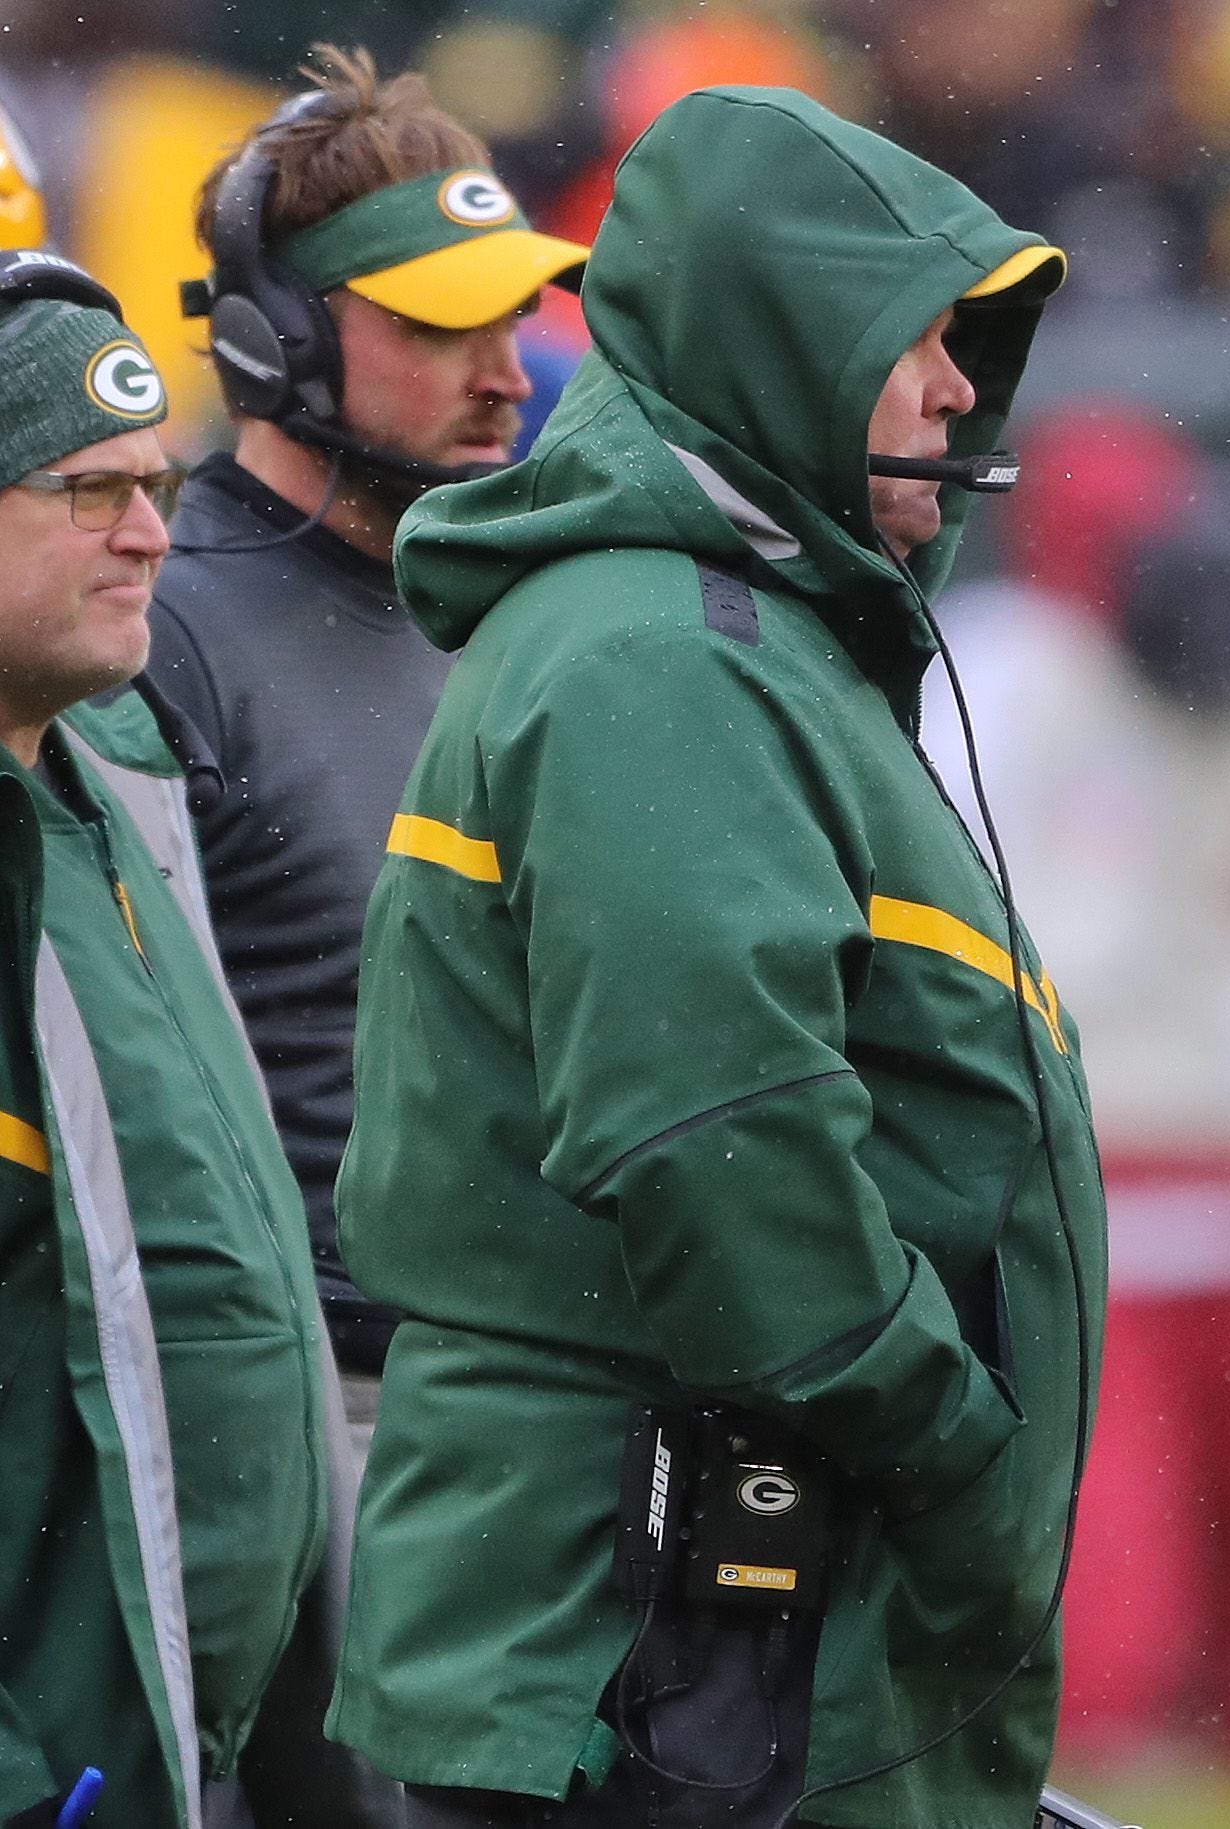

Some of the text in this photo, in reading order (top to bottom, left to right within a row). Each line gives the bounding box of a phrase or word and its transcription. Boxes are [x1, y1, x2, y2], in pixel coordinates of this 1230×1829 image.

[445, 175, 512, 220] G
[93, 348, 161, 412] G
[647, 1427, 671, 1552] BOSE
[740, 1475, 796, 1513] G
[721, 1568, 738, 1580] G
